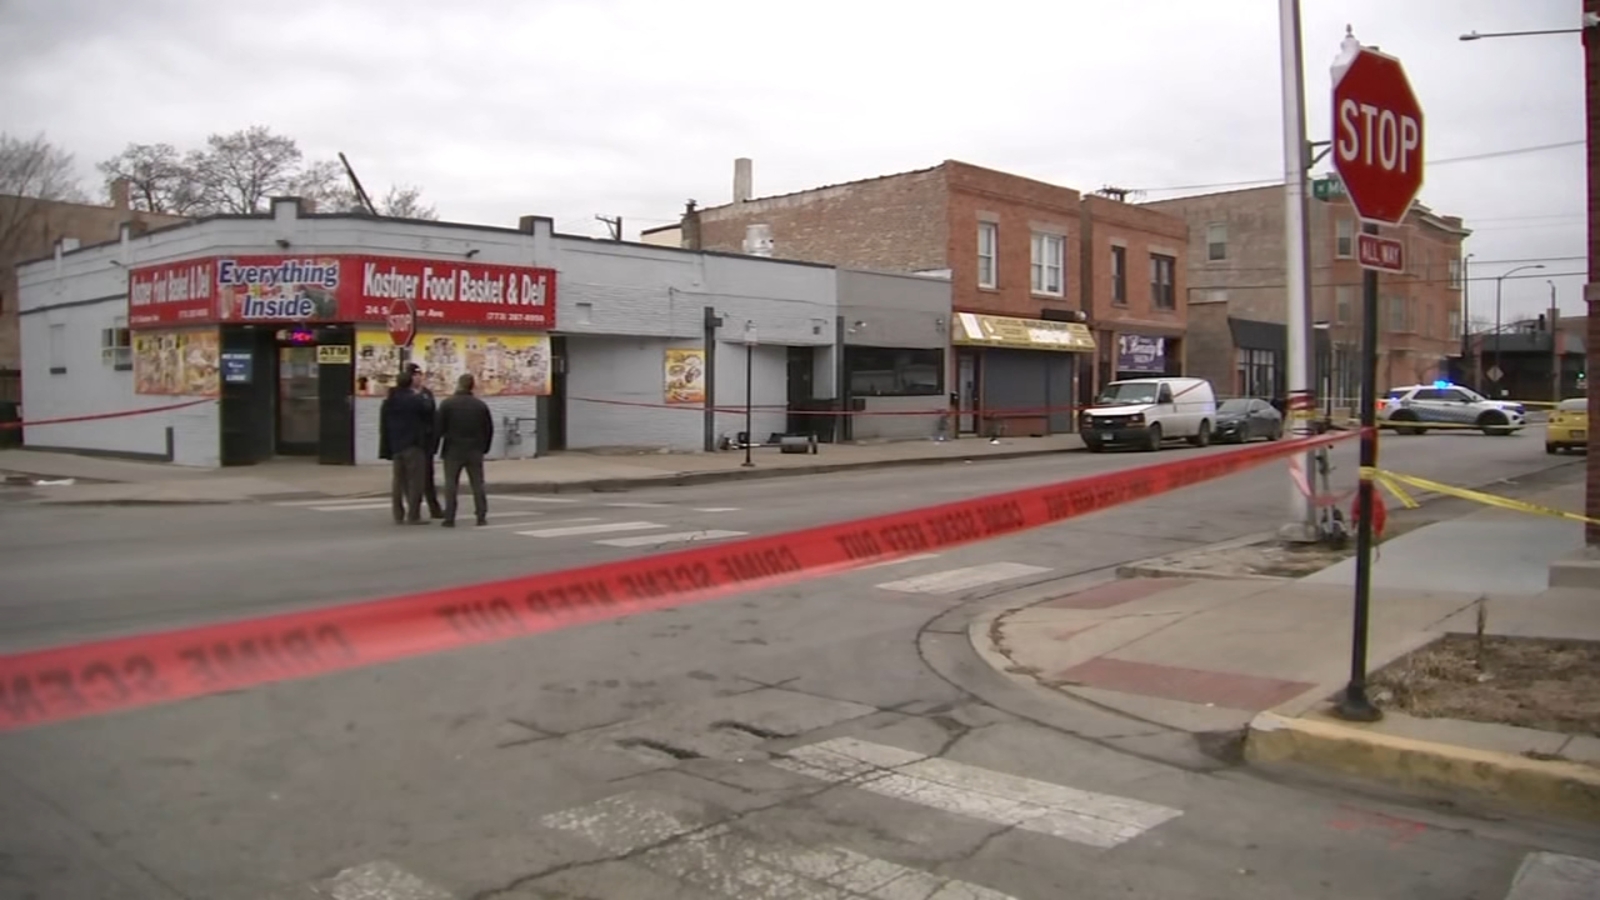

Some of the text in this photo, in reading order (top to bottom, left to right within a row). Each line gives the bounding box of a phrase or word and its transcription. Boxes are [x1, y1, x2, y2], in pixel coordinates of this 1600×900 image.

[1339, 99, 1418, 173] STOP
[1362, 242, 1401, 265] ALL WAY
[218, 259, 339, 288] Everything
[363, 262, 547, 306] Kostner Food Basket & Deli
[242, 293, 315, 318] Inside
[388, 314, 412, 332] STOP
[320, 346, 349, 356] ATM
